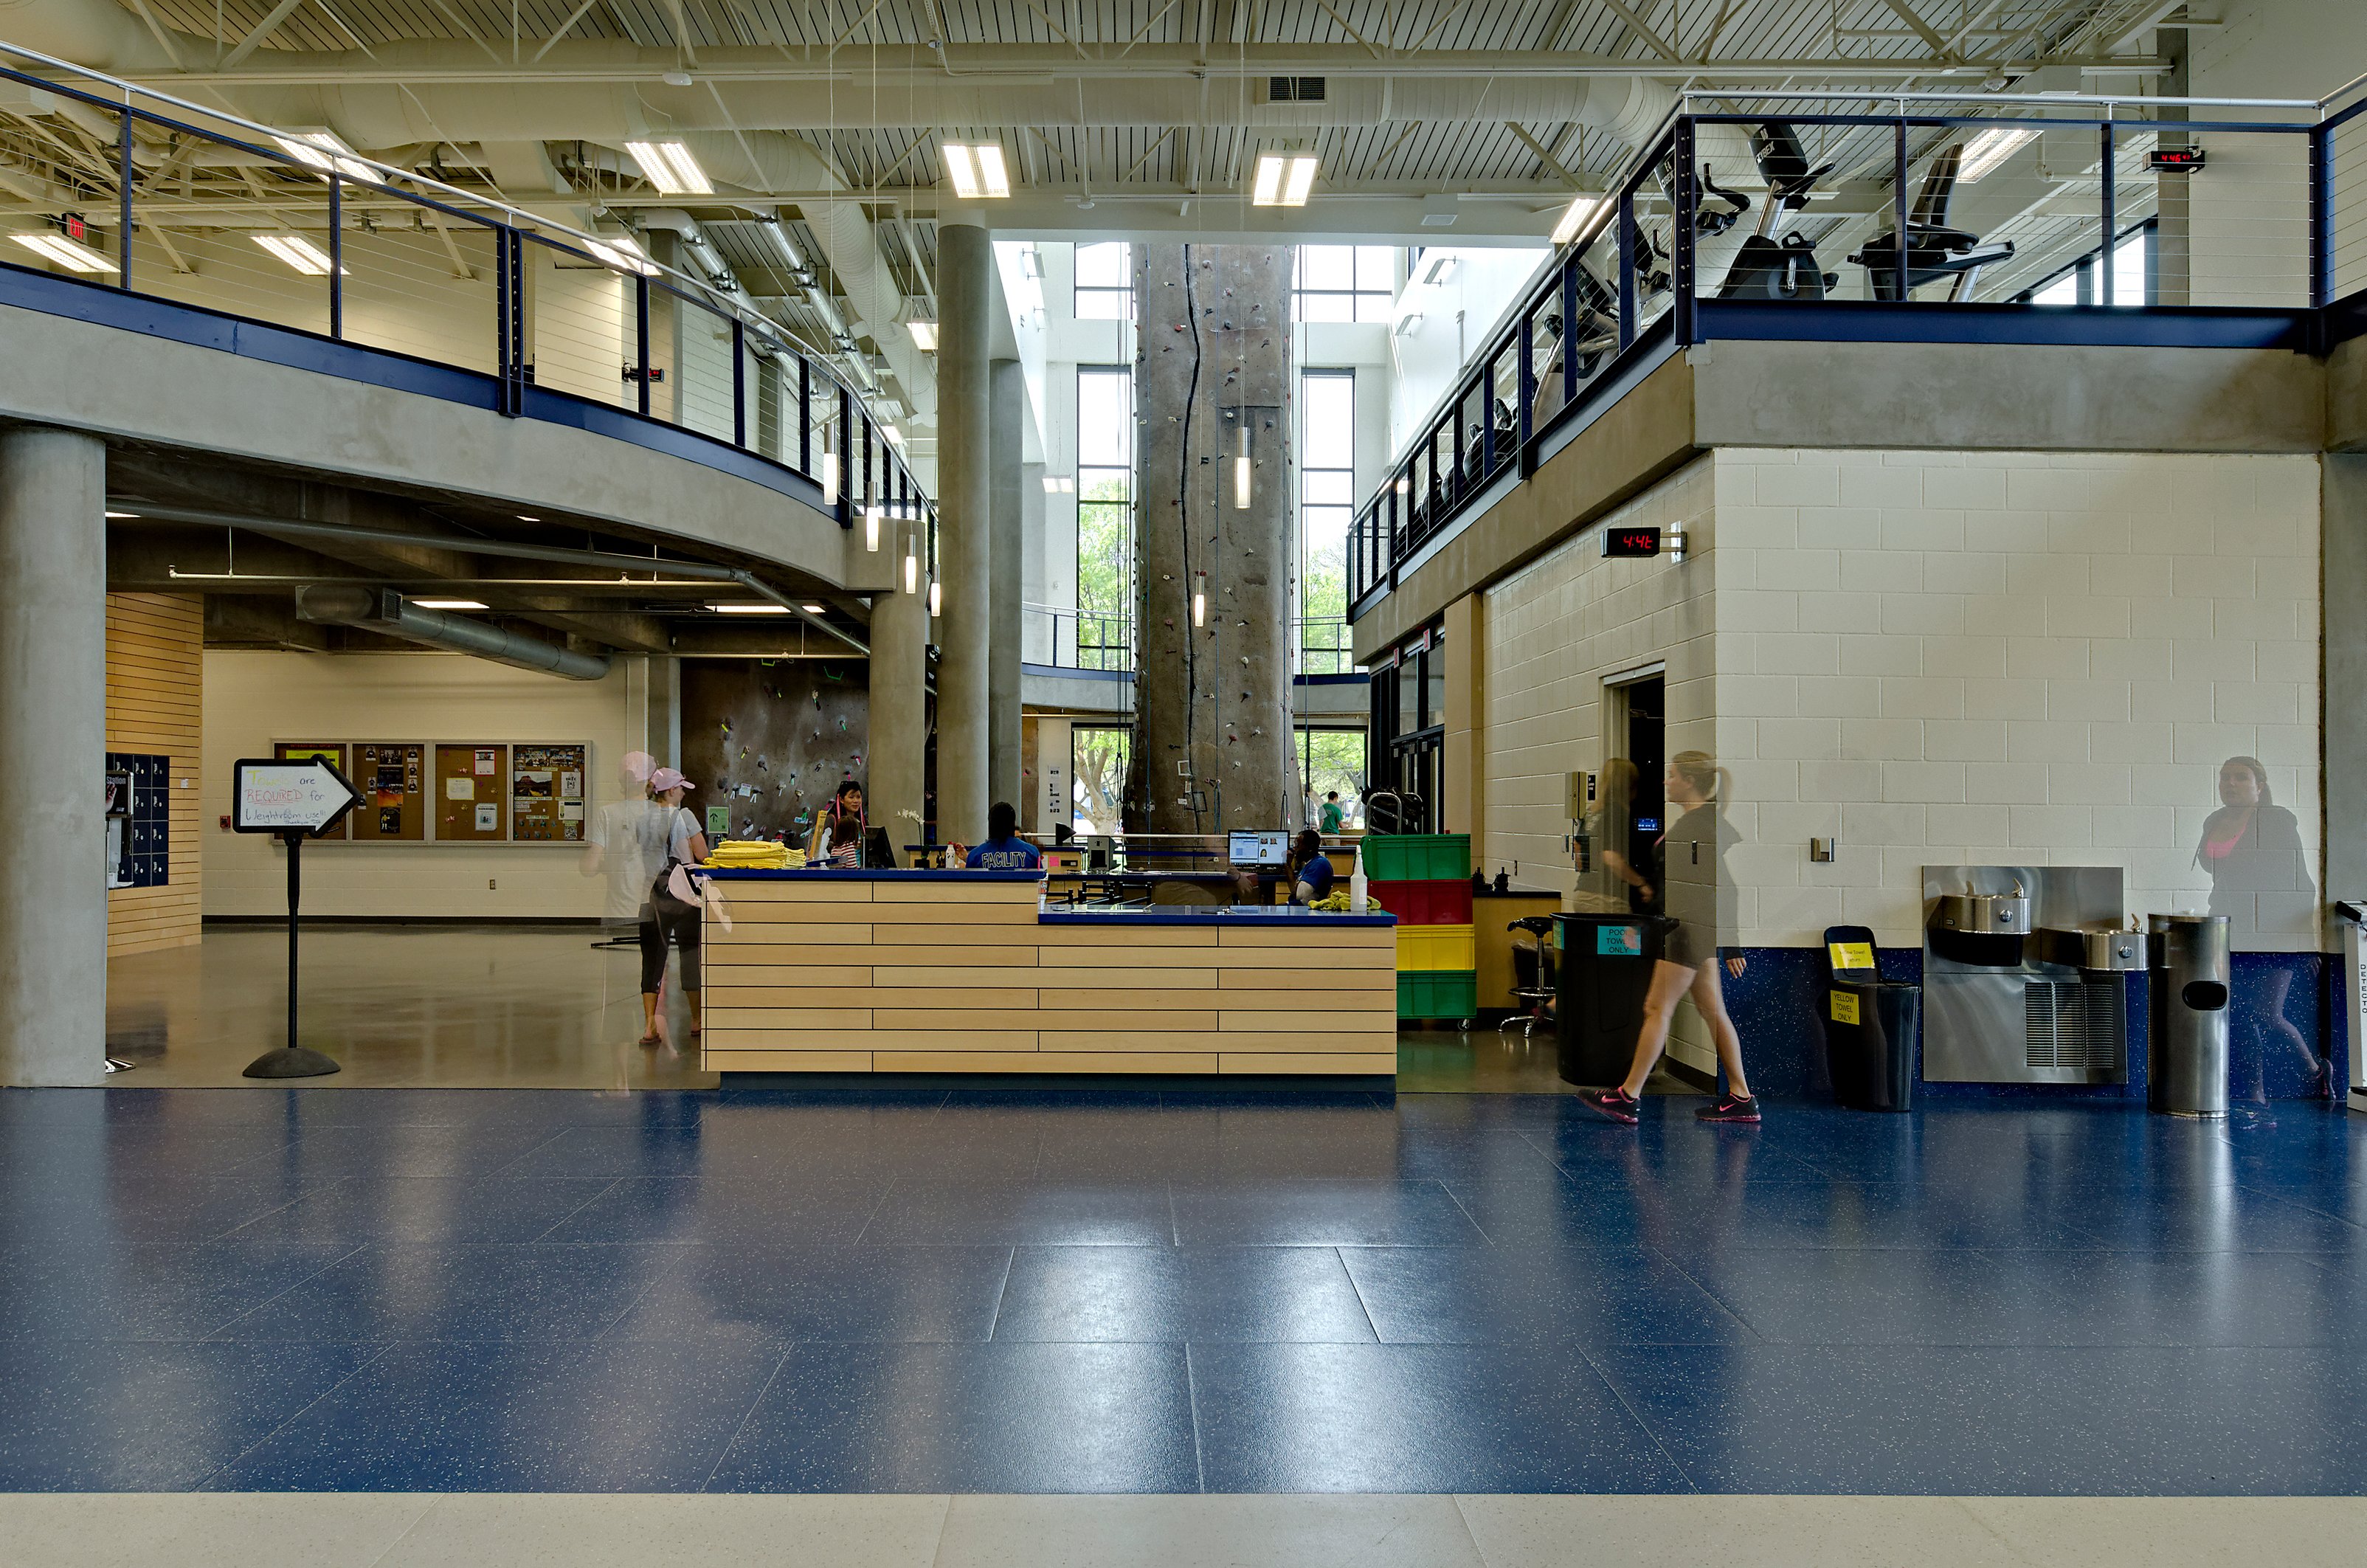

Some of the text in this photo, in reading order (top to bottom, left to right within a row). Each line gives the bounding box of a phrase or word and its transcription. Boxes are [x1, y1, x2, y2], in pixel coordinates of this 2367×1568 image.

[70, 218, 85, 240] EXIT
[245, 789, 325, 802] REQUIRED for
[981, 851, 1026, 869] FACILITY
[1834, 993, 1854, 1004] YELLOW
[1836, 1003, 1853, 1013] TOWEL
[1837, 1012, 1852, 1022] ONLY
